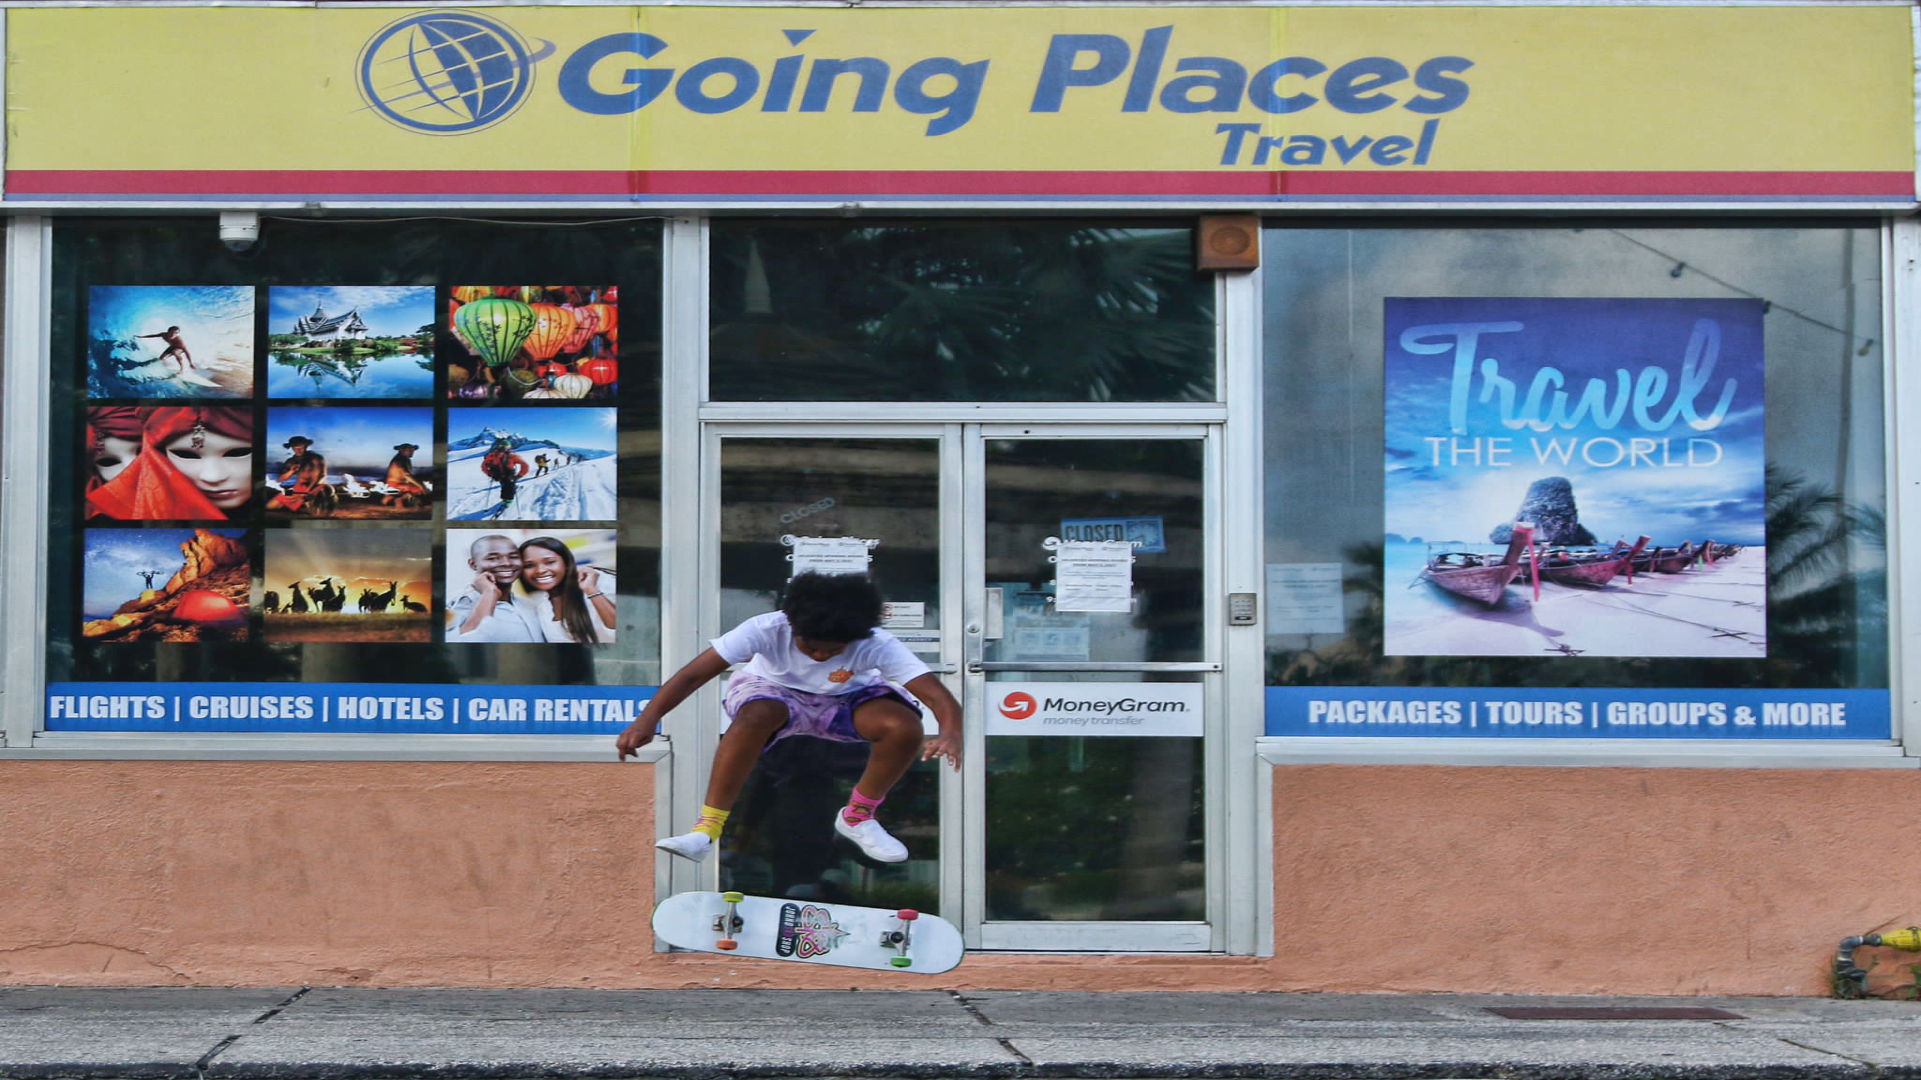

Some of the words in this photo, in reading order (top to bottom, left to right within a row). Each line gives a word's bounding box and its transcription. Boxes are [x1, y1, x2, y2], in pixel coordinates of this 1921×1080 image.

[557, 29, 990, 137] Going
[1029, 25, 1475, 114] Places
[1215, 118, 1440, 167] Travel
[1400, 318, 1738, 436] Travel
[1424, 436, 1513, 467] THE
[1530, 436, 1723, 467] WORLD
[1065, 524, 1124, 541] CLOSED
[50, 695, 166, 719] FLIGHTS
[189, 696, 314, 719] CRUISES
[337, 696, 444, 720] HOTELS
[468, 698, 527, 721] CAR
[1043, 697, 1186, 716] MoneyGram
[1308, 700, 1462, 724] PACKAGES
[1486, 701, 1584, 725] TOURS
[1607, 702, 1727, 726] GROUPS
[1734, 705, 1757, 726] &
[1763, 702, 1847, 726] MORE
[1043, 716, 1088, 726] money
[1092, 715, 1145, 726] transfer
